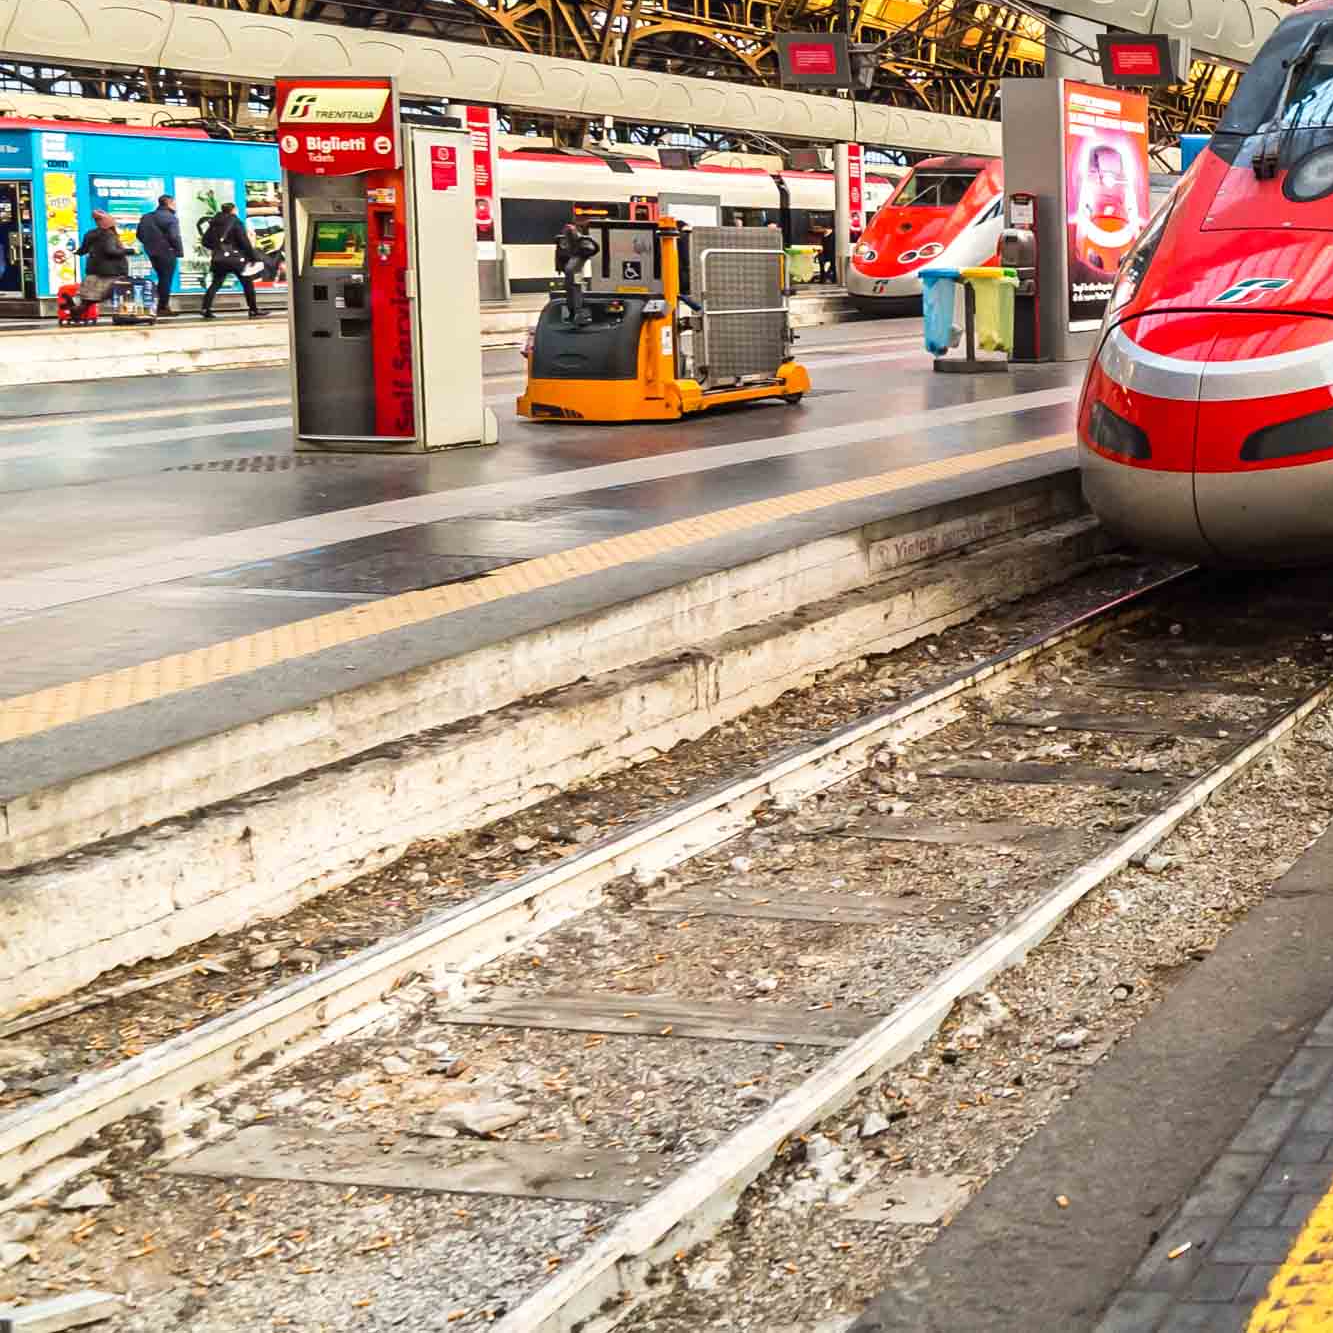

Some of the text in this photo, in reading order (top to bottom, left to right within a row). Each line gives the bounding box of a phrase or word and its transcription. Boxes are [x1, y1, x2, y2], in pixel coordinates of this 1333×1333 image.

[315, 109, 374, 120] TRENITALIA
[306, 136, 366, 154] Biglietti
[390, 268, 415, 434] Self Service
